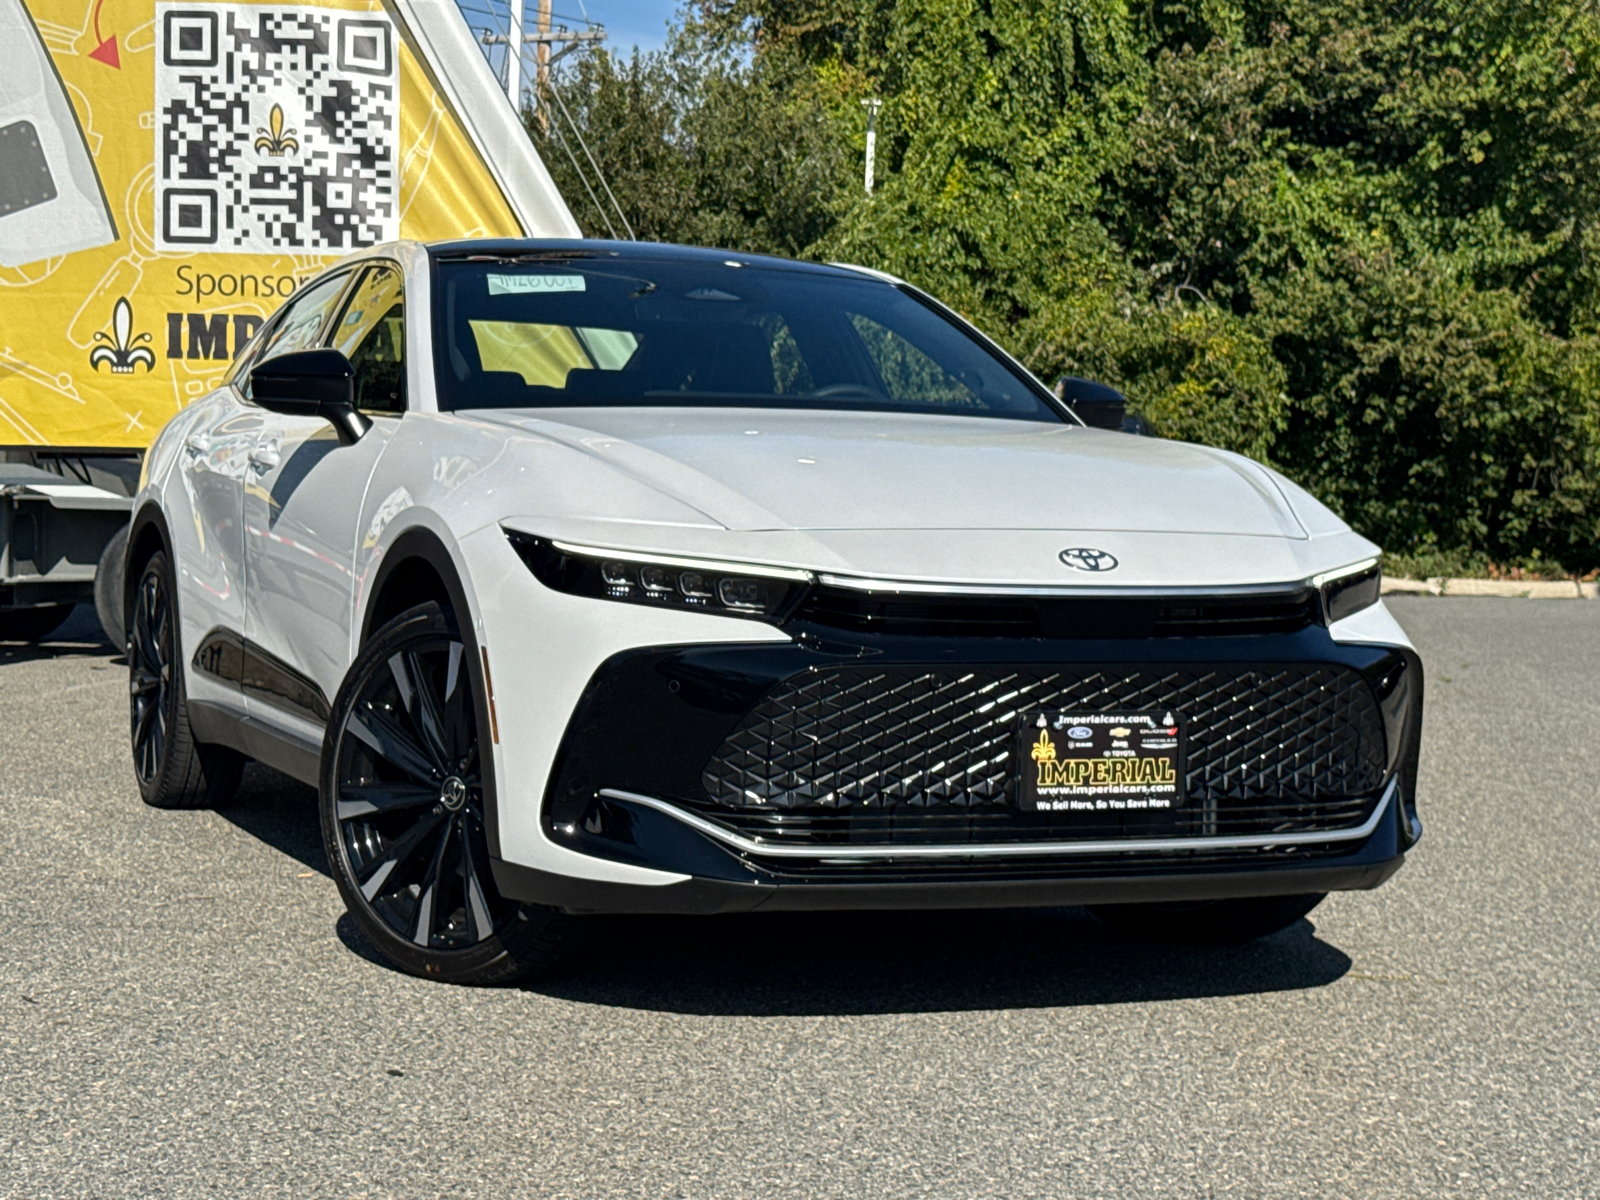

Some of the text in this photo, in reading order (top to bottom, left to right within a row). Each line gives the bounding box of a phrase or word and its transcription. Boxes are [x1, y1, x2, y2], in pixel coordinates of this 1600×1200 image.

[1037, 757, 1176, 786] IMPERIAL
[1037, 784, 1175, 796] www.imperialcars.com
[1036, 798, 1170, 810] We Sell More, So You Save More
